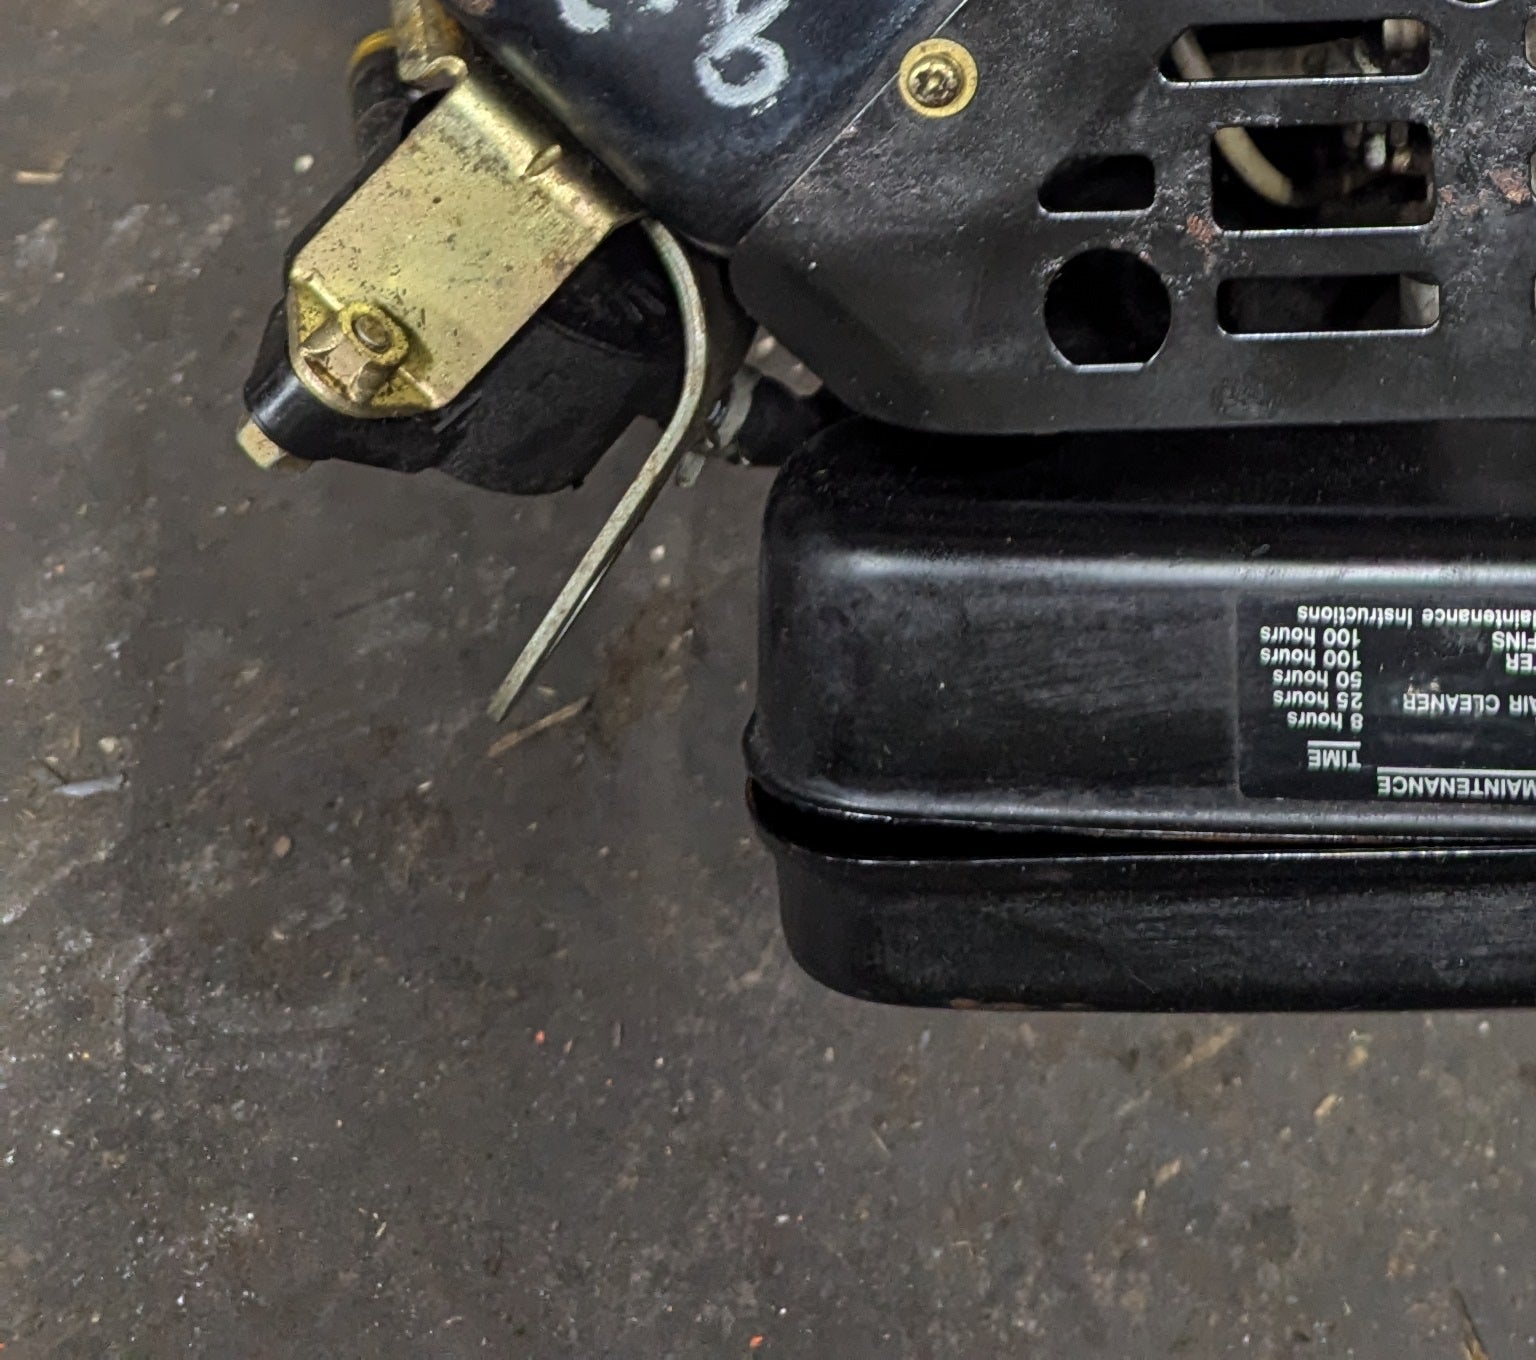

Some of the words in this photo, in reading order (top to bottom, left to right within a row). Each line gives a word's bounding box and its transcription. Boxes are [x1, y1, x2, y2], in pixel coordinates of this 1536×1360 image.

[1297, 606, 1412, 628] Instructions
[1260, 626, 1315, 646] hours
[1322, 628, 1360, 648] 100
[1260, 647, 1315, 666] hours
[1323, 649, 1360, 669] 100
[1272, 669, 1328, 688] hours
[1335, 671, 1362, 690] 50
[1273, 690, 1328, 710] hours
[1337, 693, 1362, 711] 25
[1403, 693, 1500, 717] CLEANER
[1286, 711, 1342, 730] hours
[1350, 713, 1363, 732] 8
[1307, 749, 1361, 771] TIME
